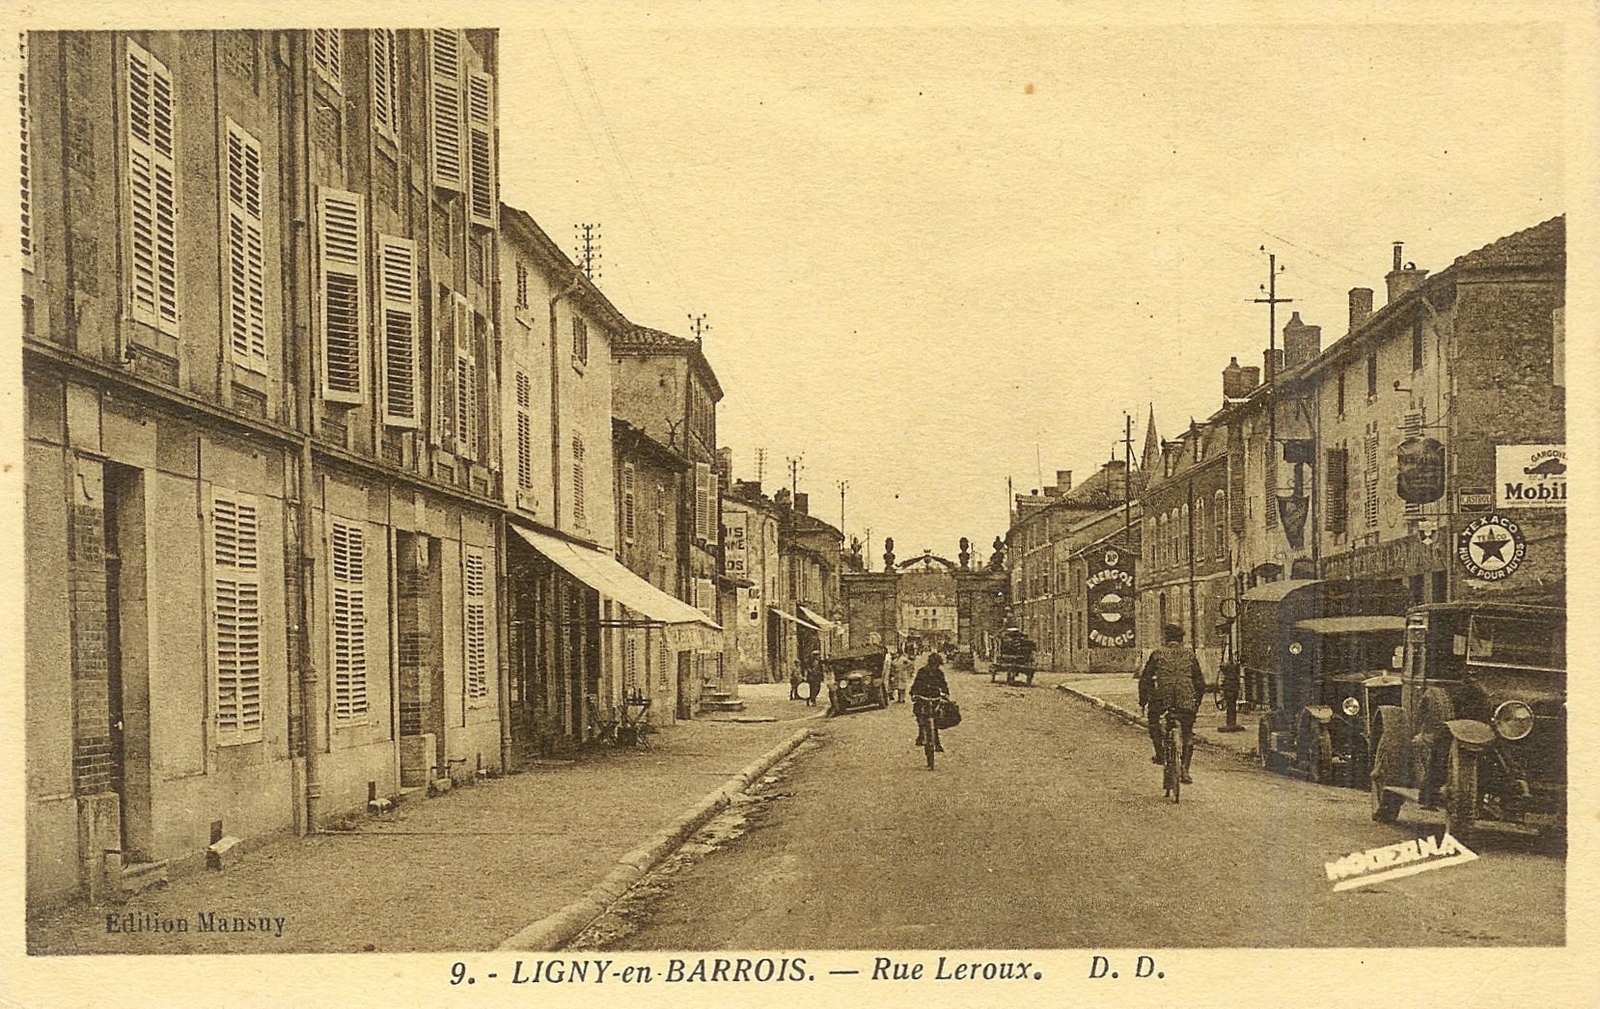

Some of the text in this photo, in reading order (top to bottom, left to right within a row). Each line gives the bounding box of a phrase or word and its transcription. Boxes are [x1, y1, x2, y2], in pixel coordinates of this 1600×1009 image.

[1531, 450, 1567, 462] GARGOYL
[1505, 482, 1567, 500] Mobil
[1462, 515, 1518, 537] TEXACO
[1477, 533, 1507, 541] TECO
[1459, 543, 1525, 579] HUILE POUR AUTOS
[1085, 569, 1133, 589] ENERGOL
[1089, 629, 1134, 647] ENERGIC
